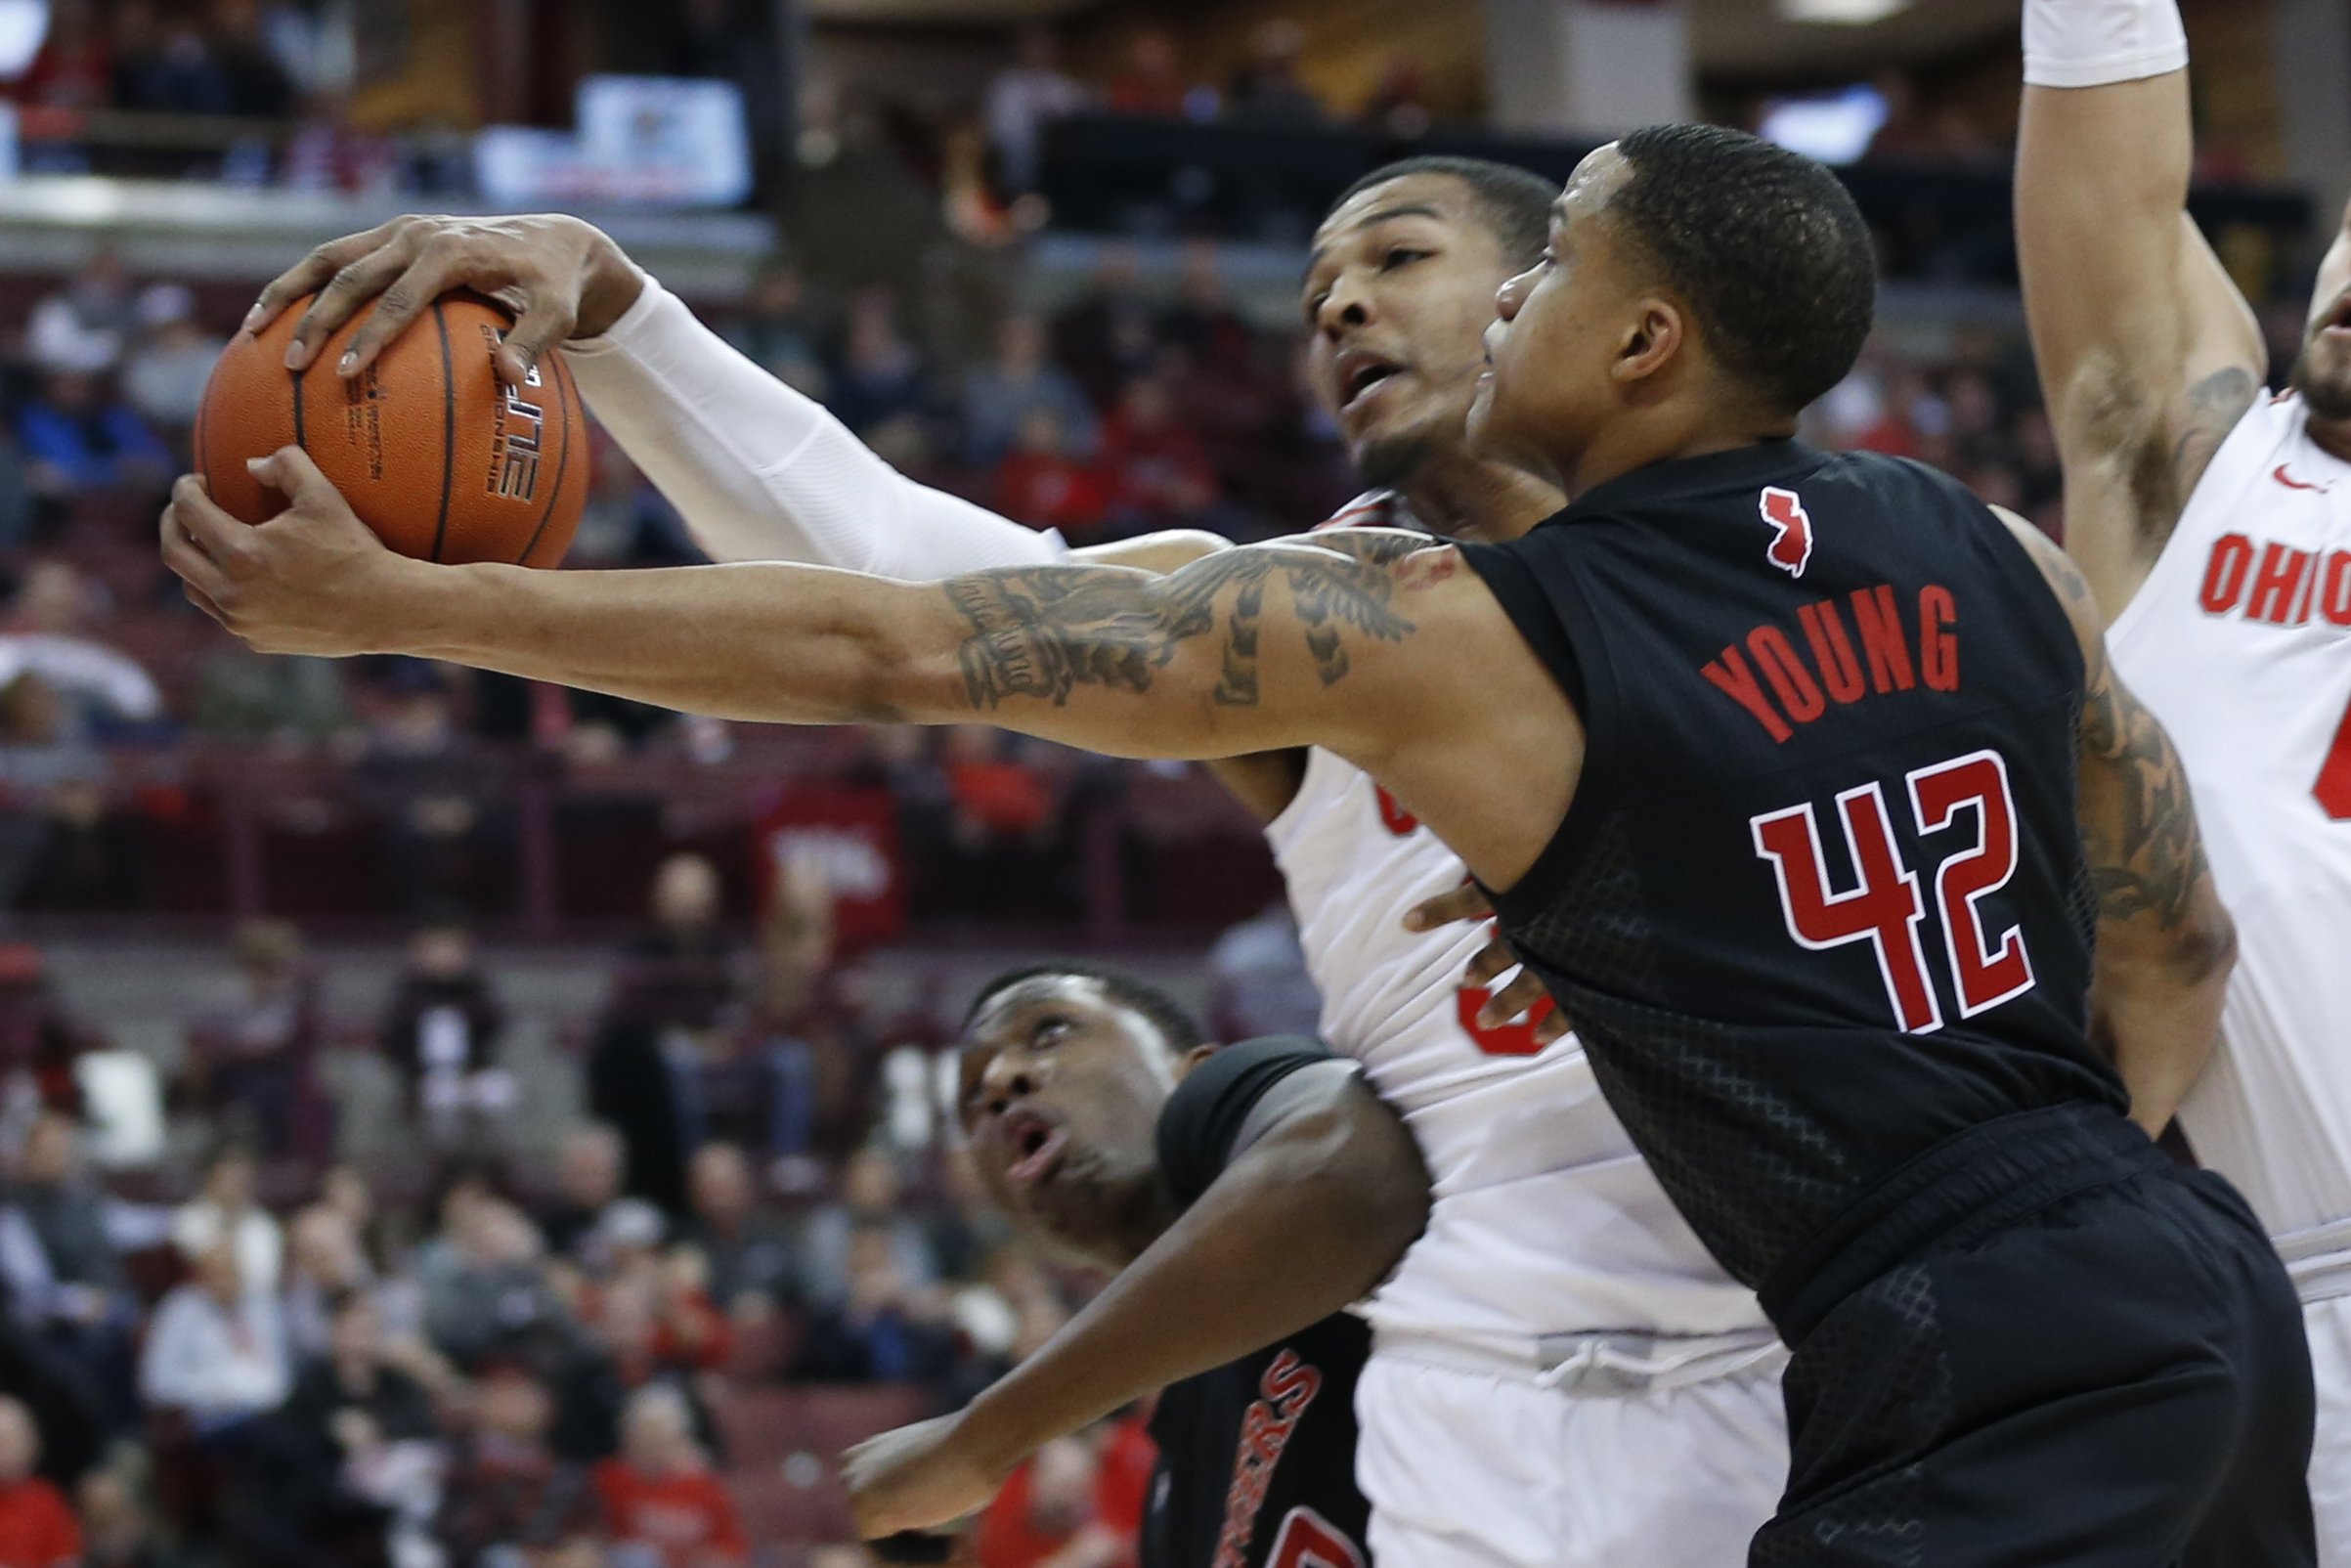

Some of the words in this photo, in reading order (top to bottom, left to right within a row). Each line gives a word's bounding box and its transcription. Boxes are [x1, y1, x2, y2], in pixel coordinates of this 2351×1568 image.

[492, 326, 543, 503] ITE
[1700, 584, 1960, 744] YOUNG
[1750, 749, 2036, 1035] 42
